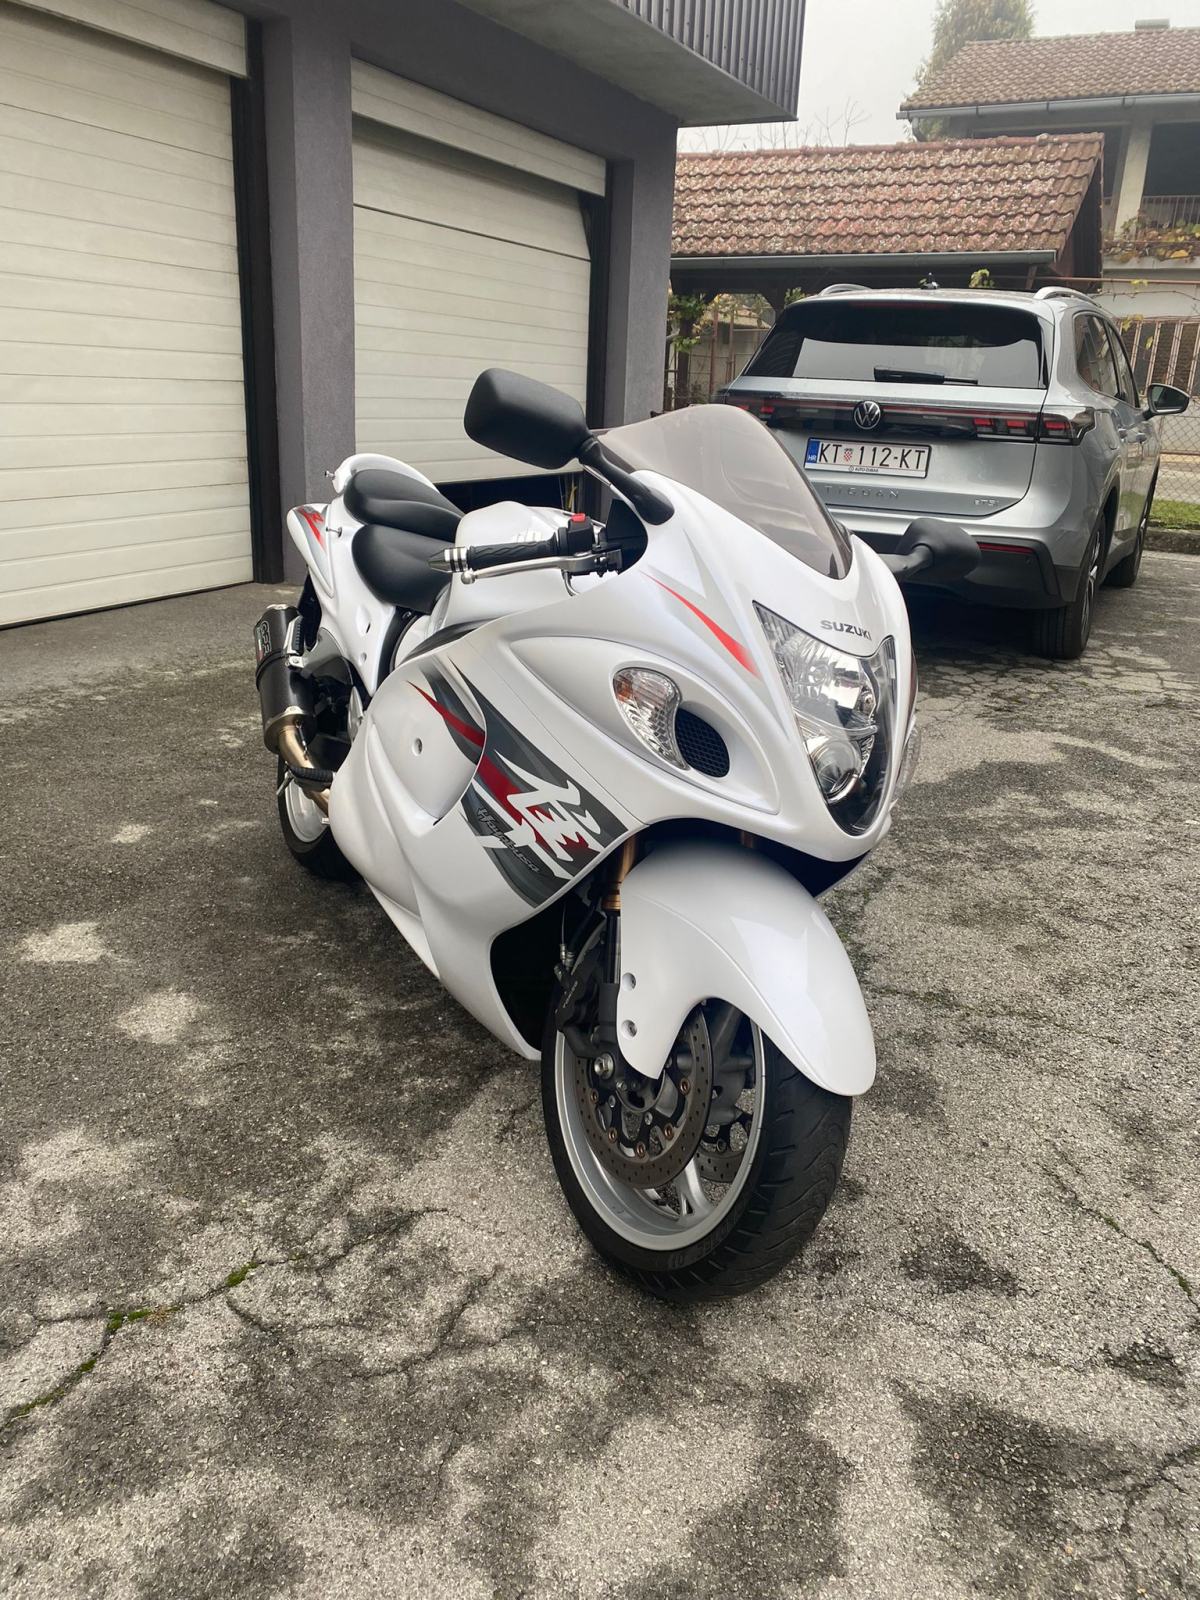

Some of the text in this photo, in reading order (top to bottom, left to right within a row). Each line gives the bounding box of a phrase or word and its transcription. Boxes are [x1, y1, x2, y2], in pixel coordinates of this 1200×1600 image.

[807, 454, 817, 462] HR
[818, 443, 926, 470] KT 112-KT
[824, 485, 899, 498] TIGUAN
[820, 619, 872, 641] SUZUKI
